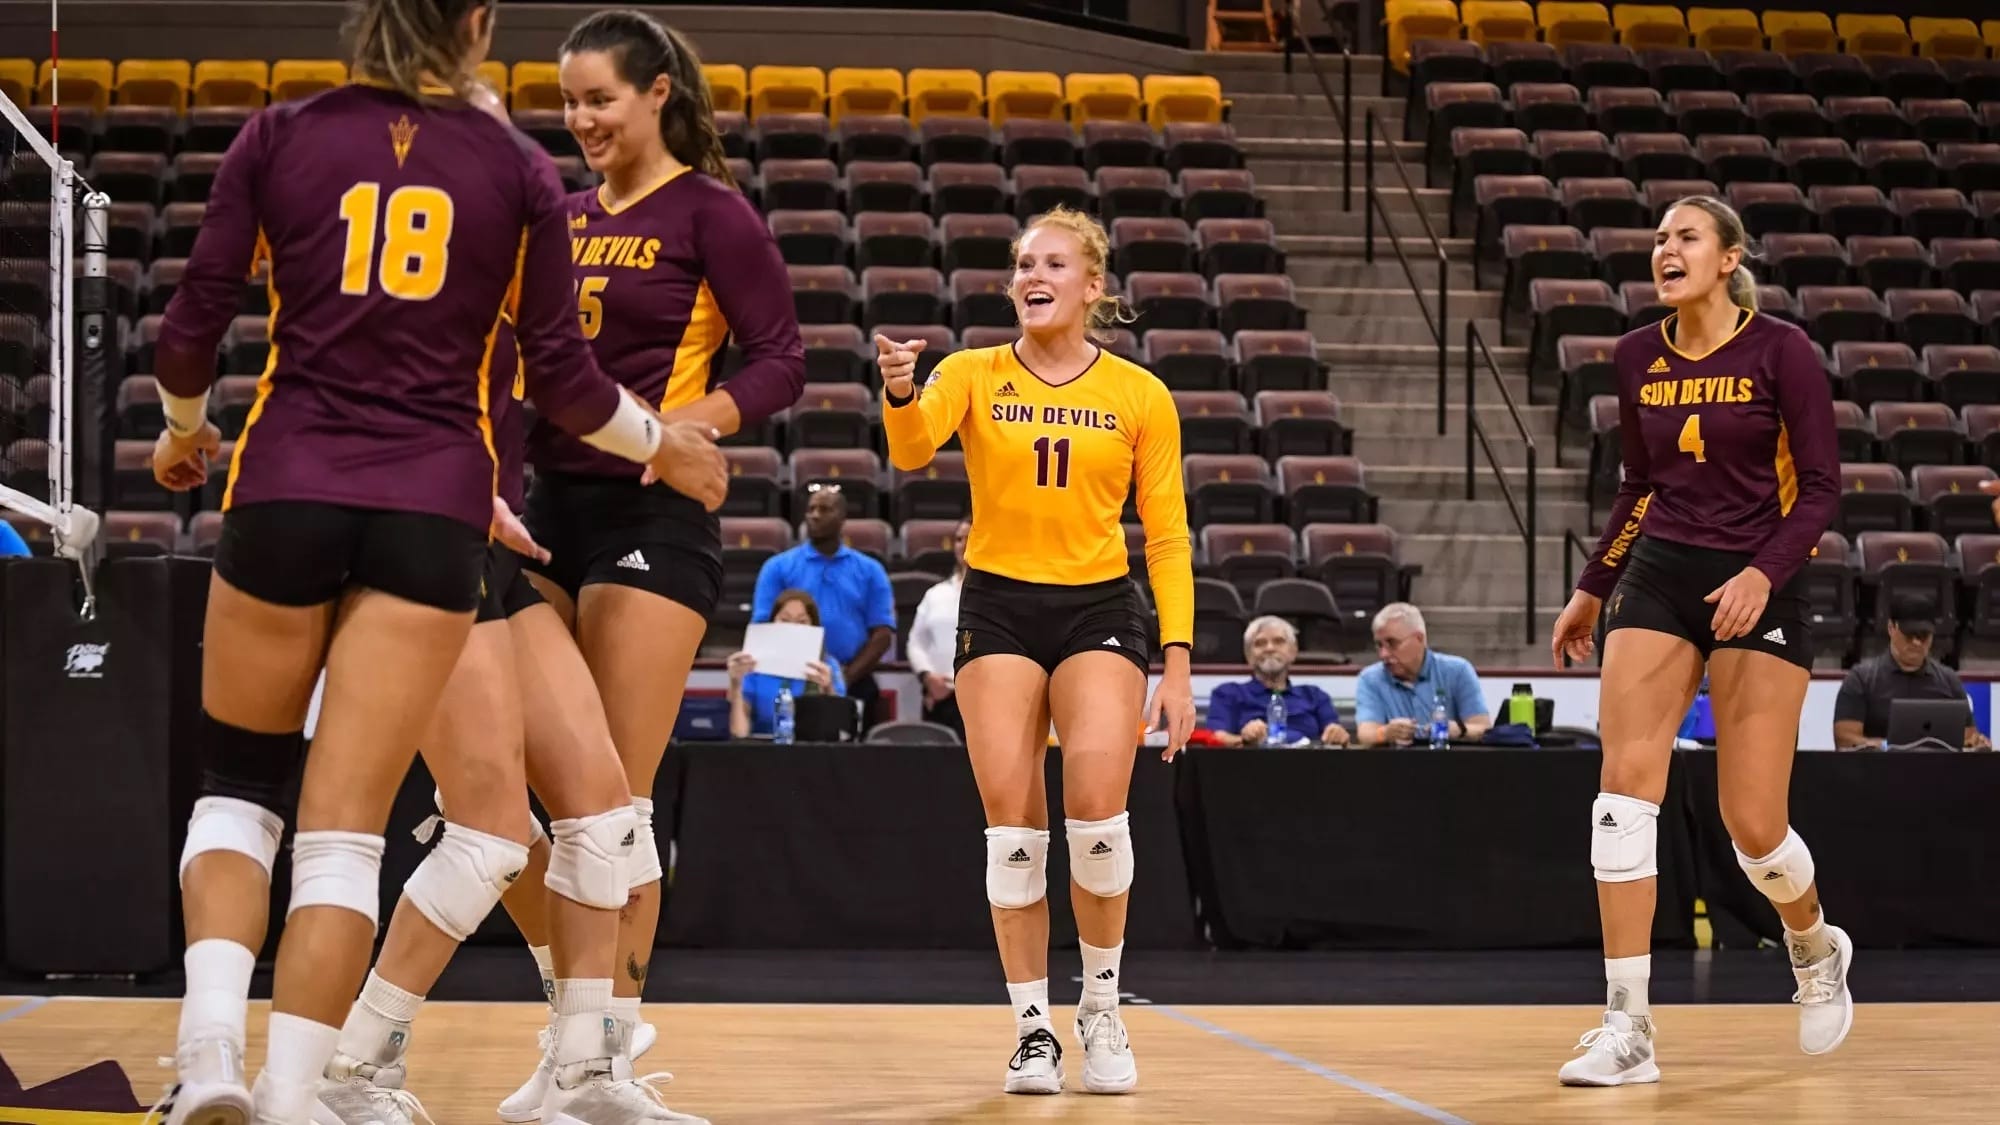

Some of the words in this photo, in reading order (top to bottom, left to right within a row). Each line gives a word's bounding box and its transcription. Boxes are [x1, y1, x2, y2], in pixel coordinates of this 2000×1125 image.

[339, 181, 455, 301] 18
[578, 236, 662, 270] DEVILS
[574, 276, 609, 341] 5
[1640, 380, 1678, 407] SUN
[1679, 376, 1753, 403] DEVILS
[991, 403, 1034, 423] SUN
[1042, 406, 1118, 431] DEVILS
[1678, 413, 1706, 463] 4
[1032, 436, 1071, 489] 11
[616, 559, 650, 571] adidas
[1601, 520, 1640, 568] FORKS
